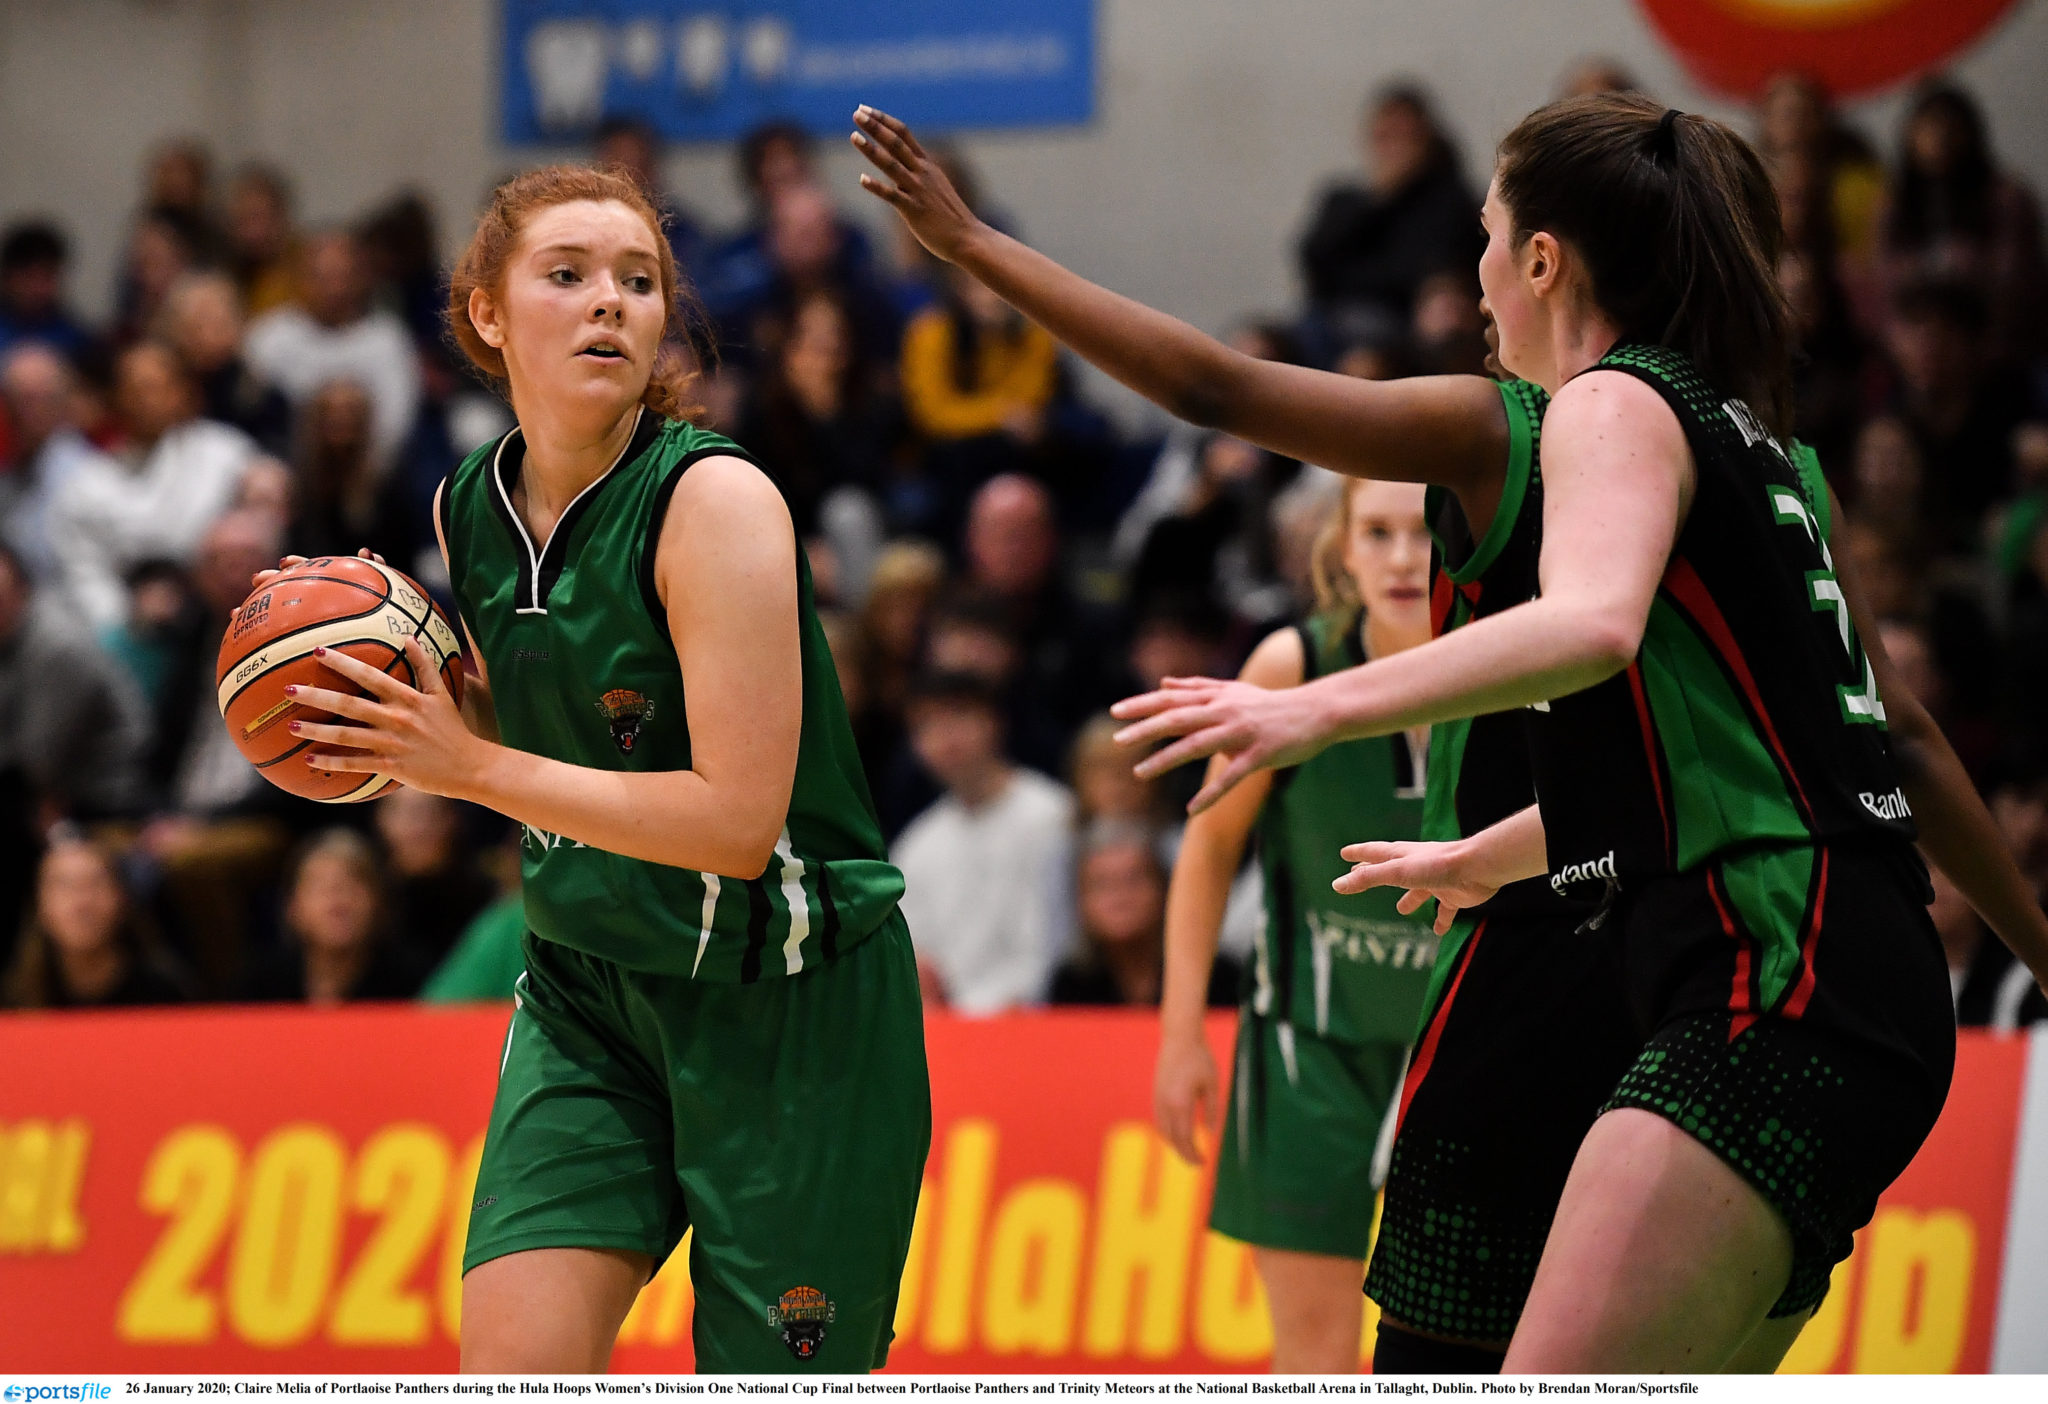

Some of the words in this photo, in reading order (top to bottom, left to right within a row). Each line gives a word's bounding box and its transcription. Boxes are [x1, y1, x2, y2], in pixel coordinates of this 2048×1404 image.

[235, 593, 272, 631] FIBA
[235, 653, 269, 684] GG6X
[1550, 849, 1619, 896] eland
[767, 1301, 836, 1327] PANTHERS
